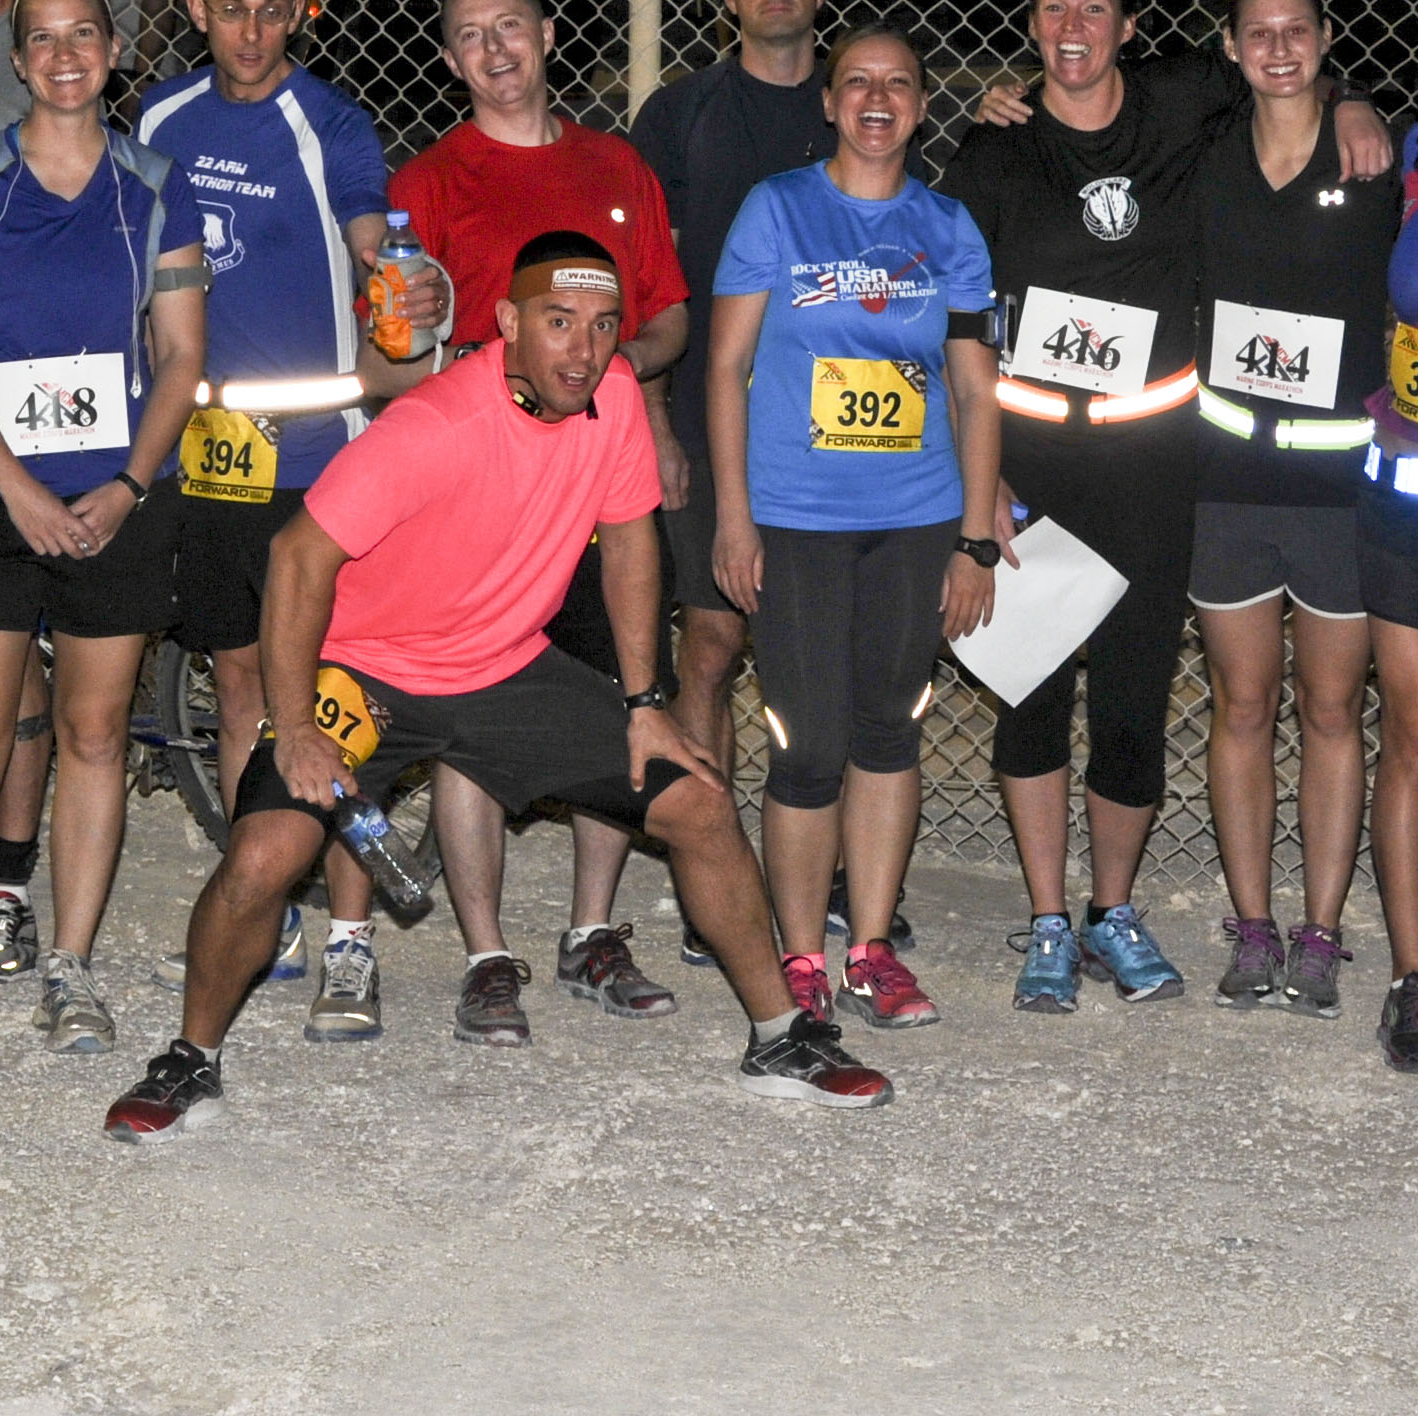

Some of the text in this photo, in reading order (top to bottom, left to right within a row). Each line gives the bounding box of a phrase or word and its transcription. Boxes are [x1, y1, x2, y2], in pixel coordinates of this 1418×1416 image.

[194, 155, 214, 169] 22
[187, 172, 277, 199] ATHON TEAM
[790, 263, 821, 276] ROCK
[837, 268, 889, 284] USA
[839, 280, 916, 294] MARATHON
[1042, 323, 1126, 372] 416
[1235, 335, 1311, 383] 414
[14, 387, 99, 432] 418
[837, 389, 902, 429] 392
[825, 434, 897, 449] FORWARD
[200, 437, 254, 479] 394
[188, 479, 249, 499] FORWARD
